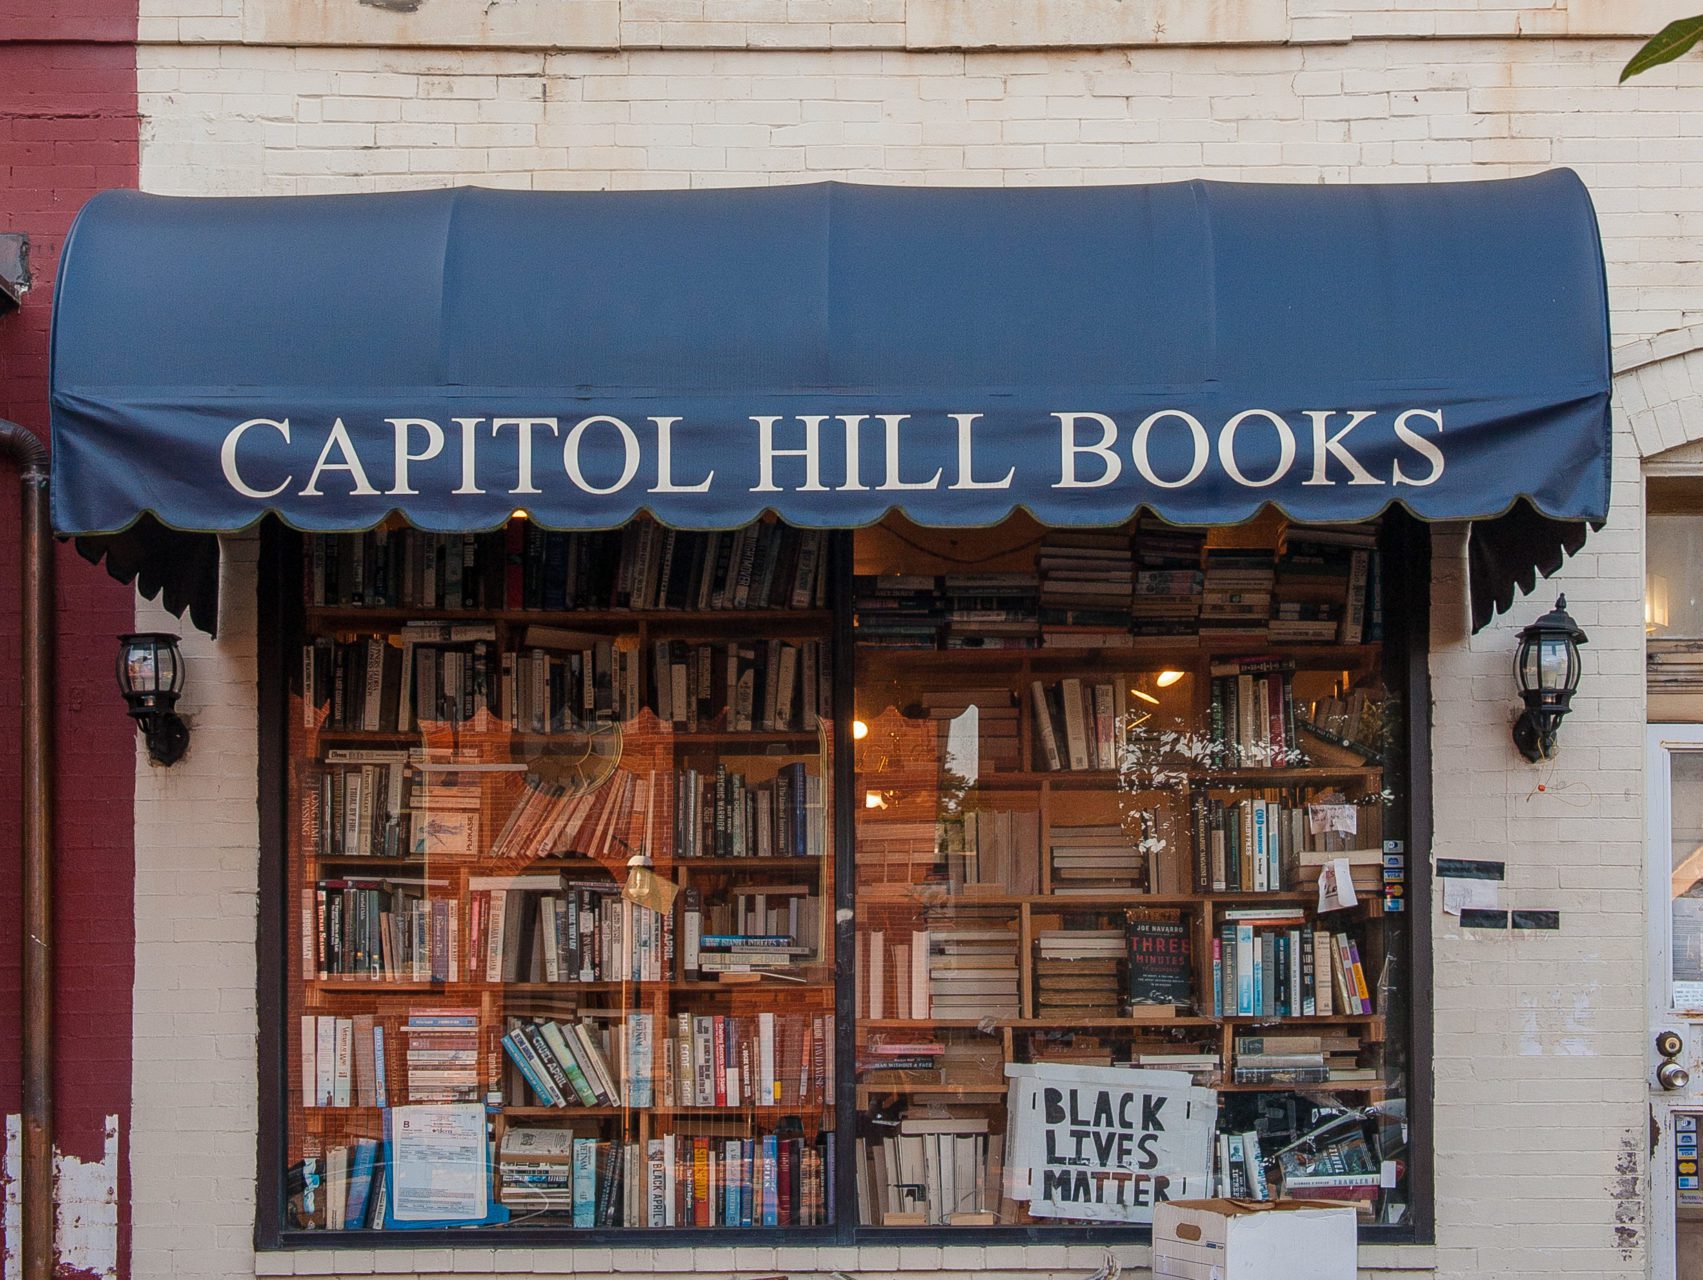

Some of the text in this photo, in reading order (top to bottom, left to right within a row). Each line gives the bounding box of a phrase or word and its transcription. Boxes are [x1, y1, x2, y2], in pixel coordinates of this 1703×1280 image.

[219, 408, 1444, 499] CAPITOL HILL BOOKS
[737, 537, 757, 586] NIGHTMOVER
[348, 787, 357, 833] TRIAL BY FIRE
[716, 770, 725, 831] PSYCHIC WARRIOR
[302, 797, 310, 835] PASSING
[311, 790, 319, 843] LONG TIME
[1255, 808, 1265, 825] COLD
[1199, 852, 1207, 877] MAGAZINE
[568, 903, 576, 924] WHERE
[1136, 924, 1184, 933] JOE NAVARRO
[318, 904, 327, 962] VIETNAM SHADOWS
[568, 924, 576, 939] THEY
[1130, 936, 1190, 954] THREE
[302, 936, 312, 959] VALLEY
[664, 933, 673, 961] APRIL
[1136, 954, 1185, 965] MINUTES
[635, 1017, 643, 1047] VIETNAM
[679, 1013, 688, 1033] THE
[532, 1036, 567, 1089] CRUEL APRIL
[680, 1044, 689, 1070] CODE
[814, 1042, 824, 1066] DAVID
[488, 1052, 498, 1091] Tonkin Gulf
[815, 1066, 825, 1088] WISE
[1044, 1087, 1169, 1131] BLACK
[579, 1142, 588, 1170] VIETNAM
[1045, 1129, 1159, 1170] LIVES
[694, 1148, 706, 1200] SIDESHOW
[1043, 1169, 1170, 1207] MATTER
[653, 1163, 663, 1219] BLACK APRIL
